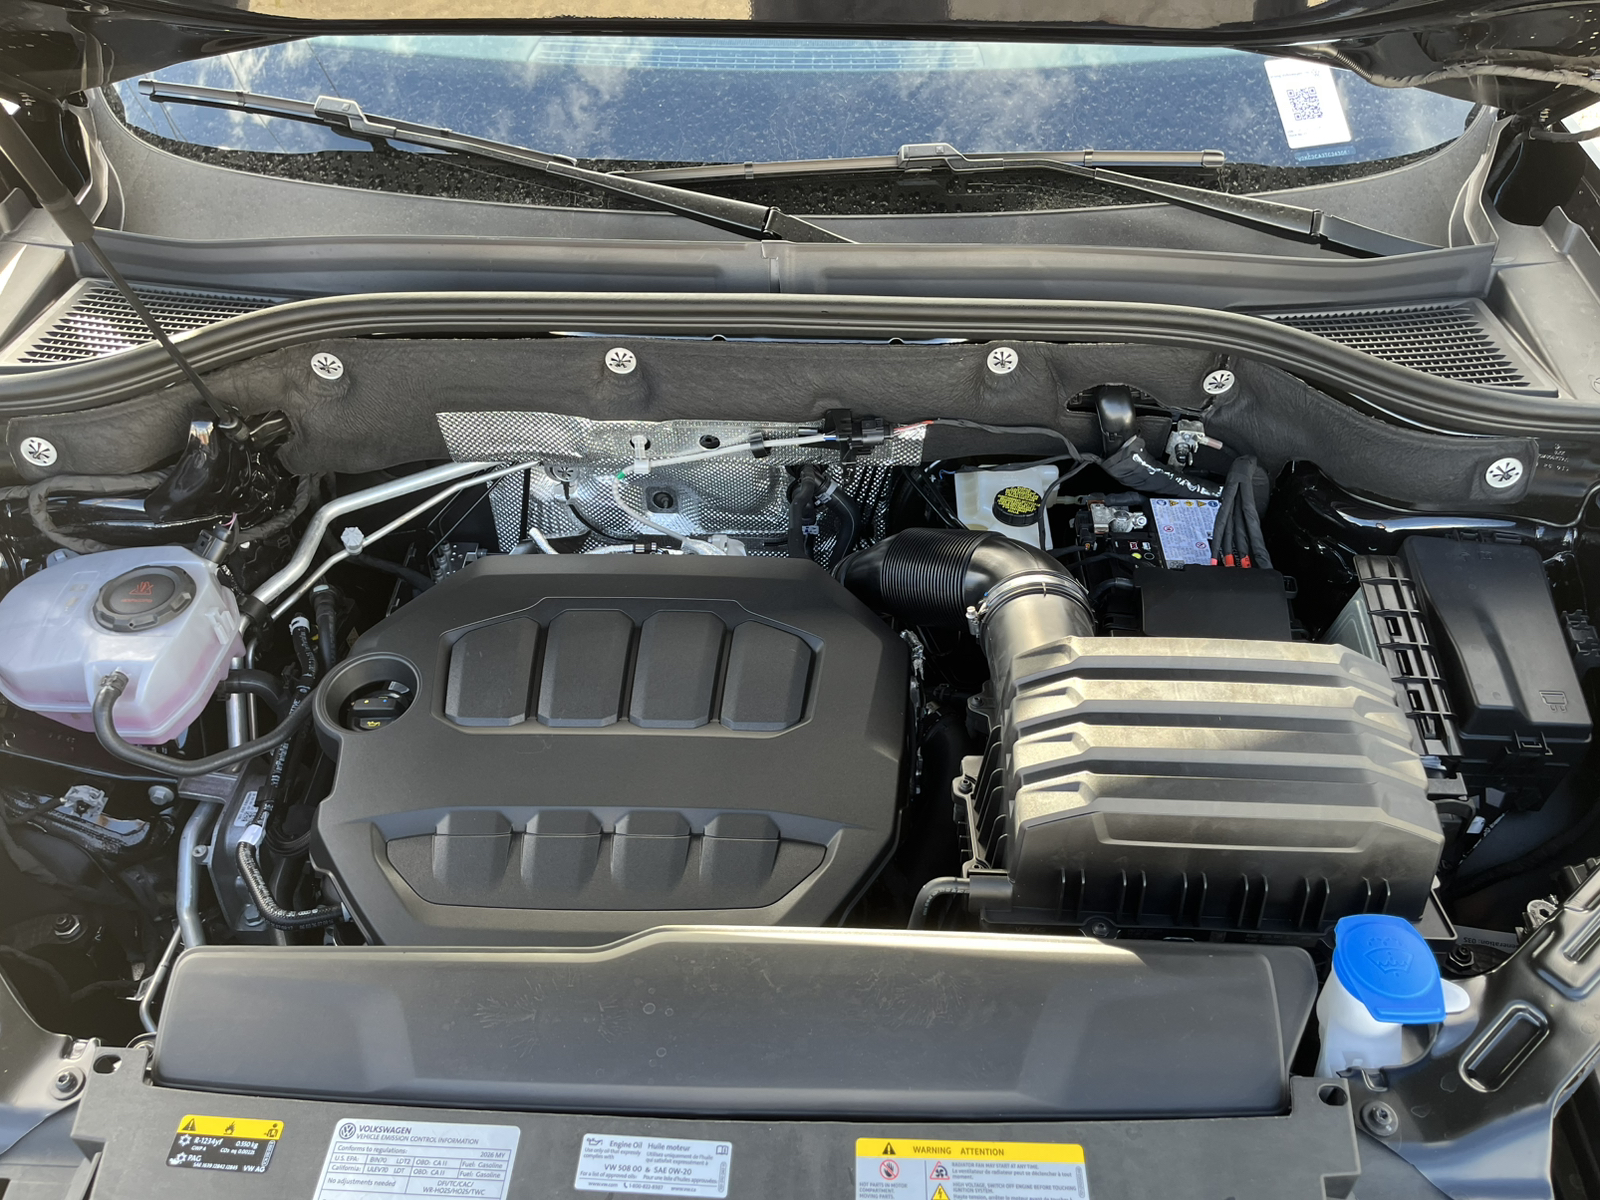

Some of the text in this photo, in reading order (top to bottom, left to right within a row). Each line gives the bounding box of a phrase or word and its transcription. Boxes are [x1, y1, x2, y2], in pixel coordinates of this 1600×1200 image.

[1478, 939, 1517, 949] eneration:
[359, 1125, 412, 1134] VOLKSWAGEN
[194, 1137, 223, 1146] R-1234yf
[610, 1140, 631, 1149] Engine
[913, 1146, 1005, 1156] WARNING ATTENTION
